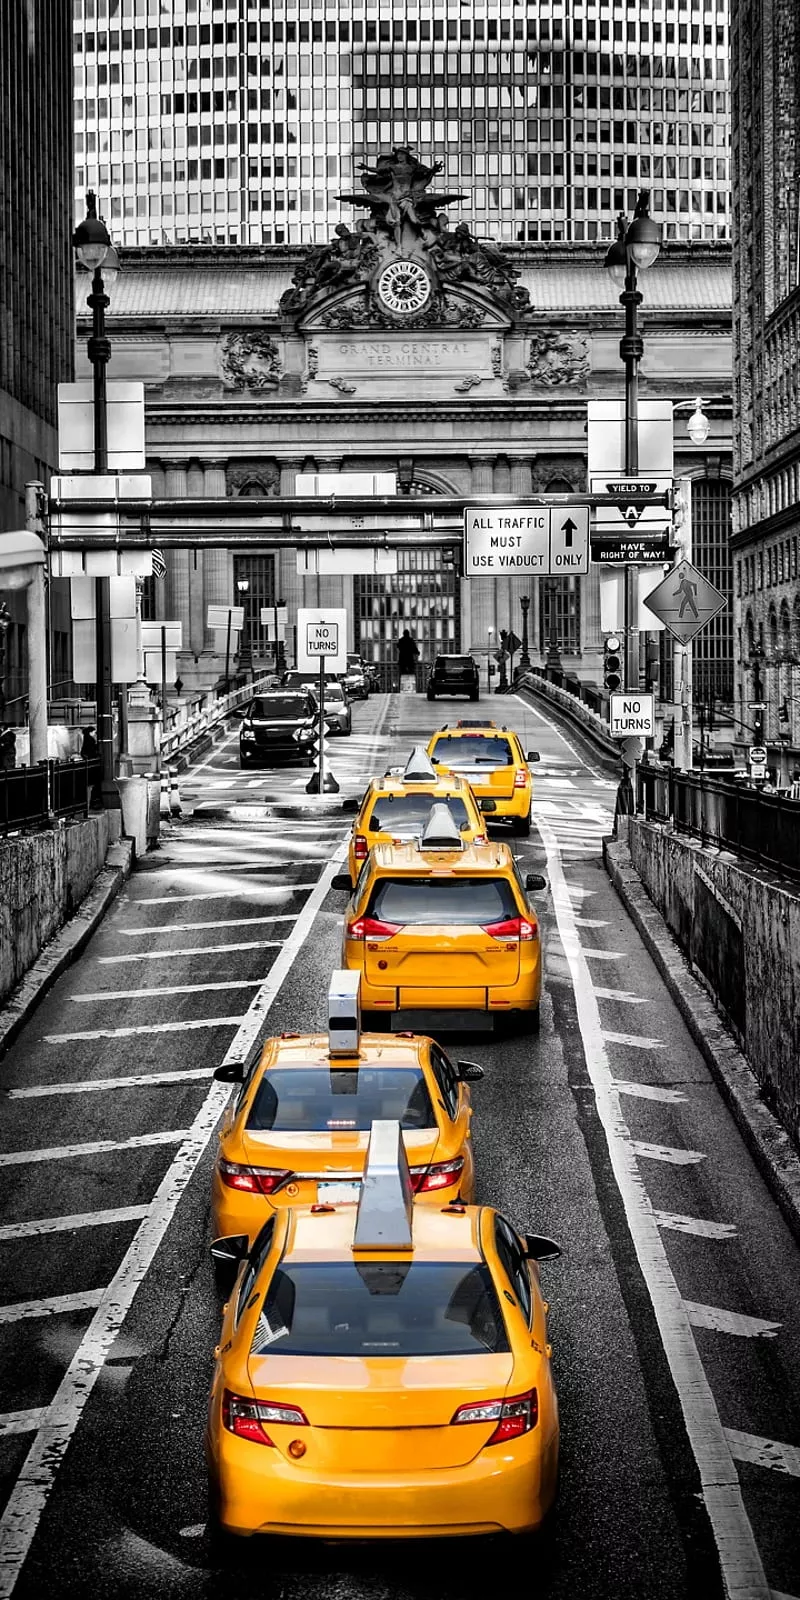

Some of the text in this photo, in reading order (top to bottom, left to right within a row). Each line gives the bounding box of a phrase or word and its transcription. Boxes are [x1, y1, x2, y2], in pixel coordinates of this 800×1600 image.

[340, 343, 469, 354] GRAND CENTRAL
[368, 355, 441, 365] TERMINAL
[472, 517, 545, 529] ALL TRAFFIC
[490, 536, 522, 548] MUST
[620, 543, 645, 551] HAVE
[555, 554, 583, 566] ONLY
[600, 551, 666, 559] RIGHT OF WAY!
[472, 555, 544, 567] USE VIADUCT
[315, 628, 330, 638] NO
[308, 641, 337, 650] TURNS
[623, 701, 641, 713] NO
[613, 718, 651, 730] TURNS
